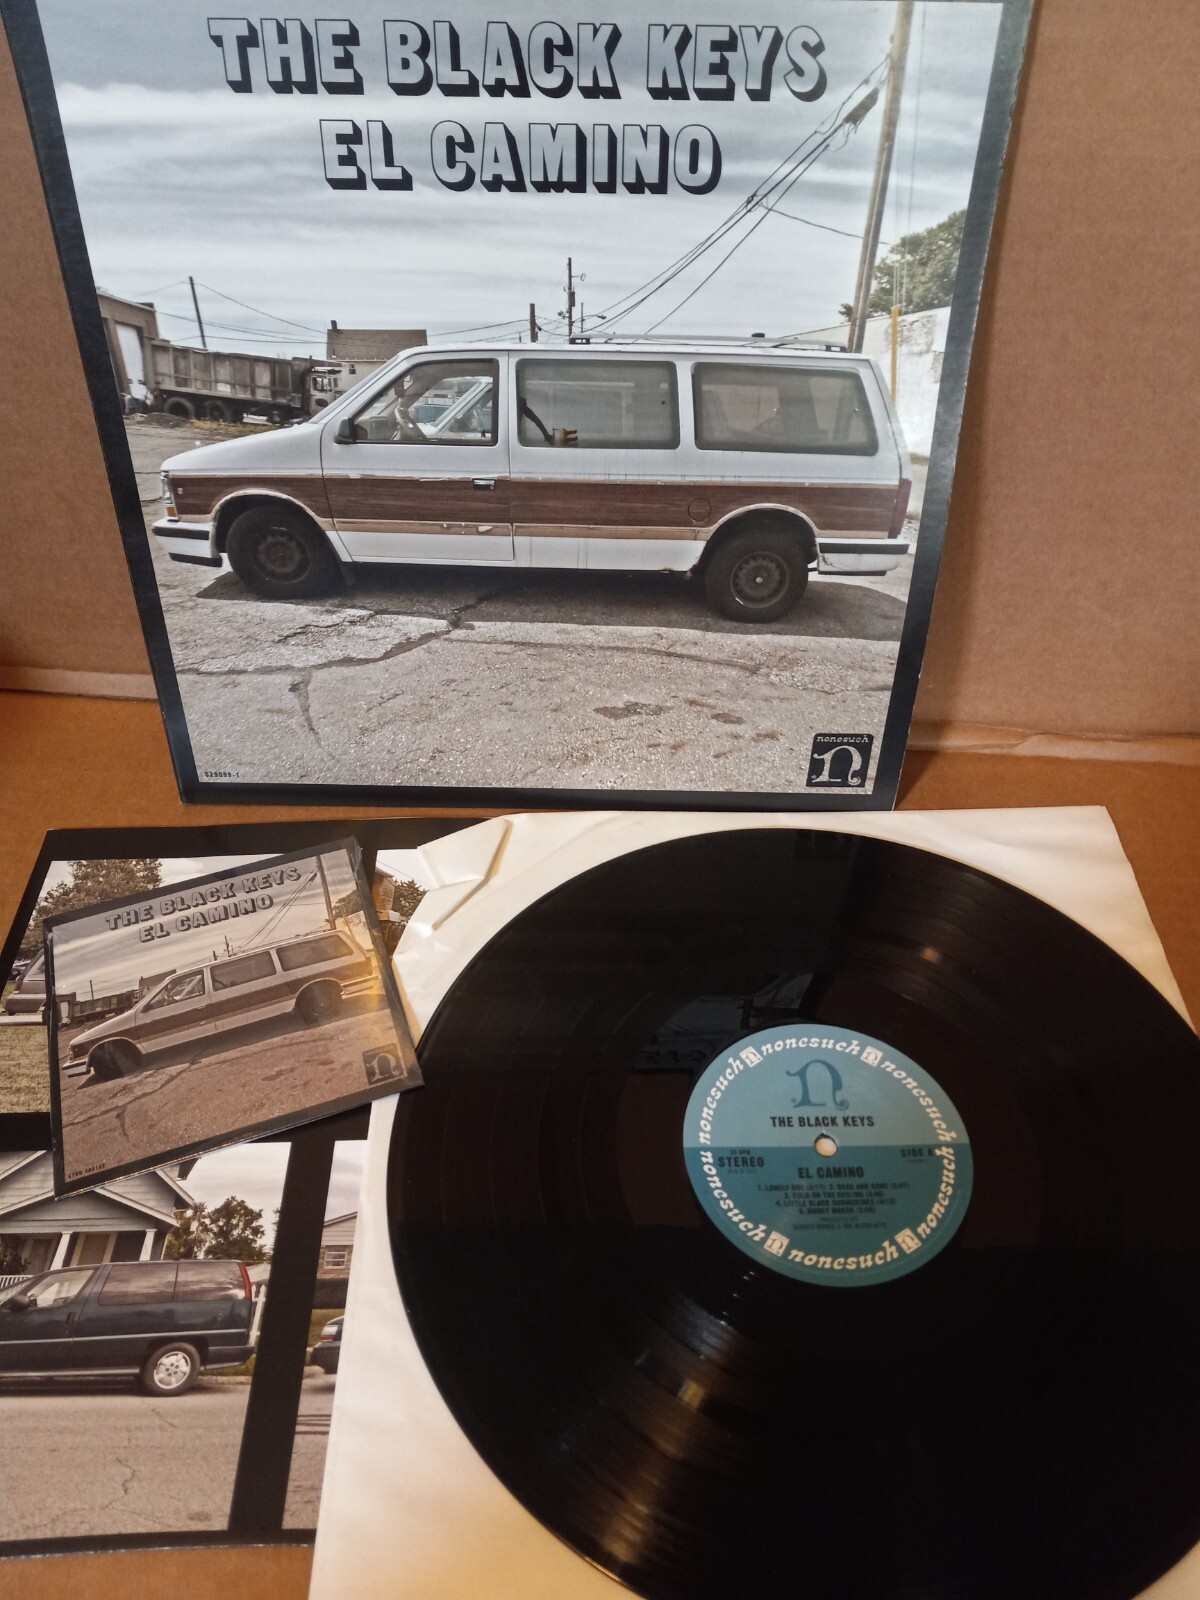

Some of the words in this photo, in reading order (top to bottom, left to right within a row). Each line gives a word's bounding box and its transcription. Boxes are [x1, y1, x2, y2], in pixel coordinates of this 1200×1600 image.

[206, 17, 365, 96] THE
[383, 19, 622, 100] BLACK
[646, 23, 828, 102] KEYS
[319, 118, 413, 192] EL
[429, 119, 723, 195] CAMINO
[816, 735, 869, 743] nonesuch
[105, 905, 154, 931] THE
[160, 882, 237, 916] BLACK
[242, 867, 301, 893] KEYS
[138, 923, 170, 943] EL
[175, 893, 274, 932] CAMINO
[761, 1037, 861, 1056] nonesuch
[699, 1058, 744, 1145] nonesuch
[769, 1116, 794, 1127] THE
[798, 1116, 838, 1127] BLACK
[843, 1115, 875, 1127] KEYS
[880, 1060, 958, 1142] nonesuch
[718, 1156, 765, 1168] STEREO
[798, 1167, 813, 1179] EL
[817, 1166, 864, 1178] CAMINO
[900, 1148, 924, 1158] SIDE
[700, 1151, 767, 1242] nonesuch
[917, 1147, 956, 1239] nonesuch
[788, 1241, 899, 1270] nonesuch
